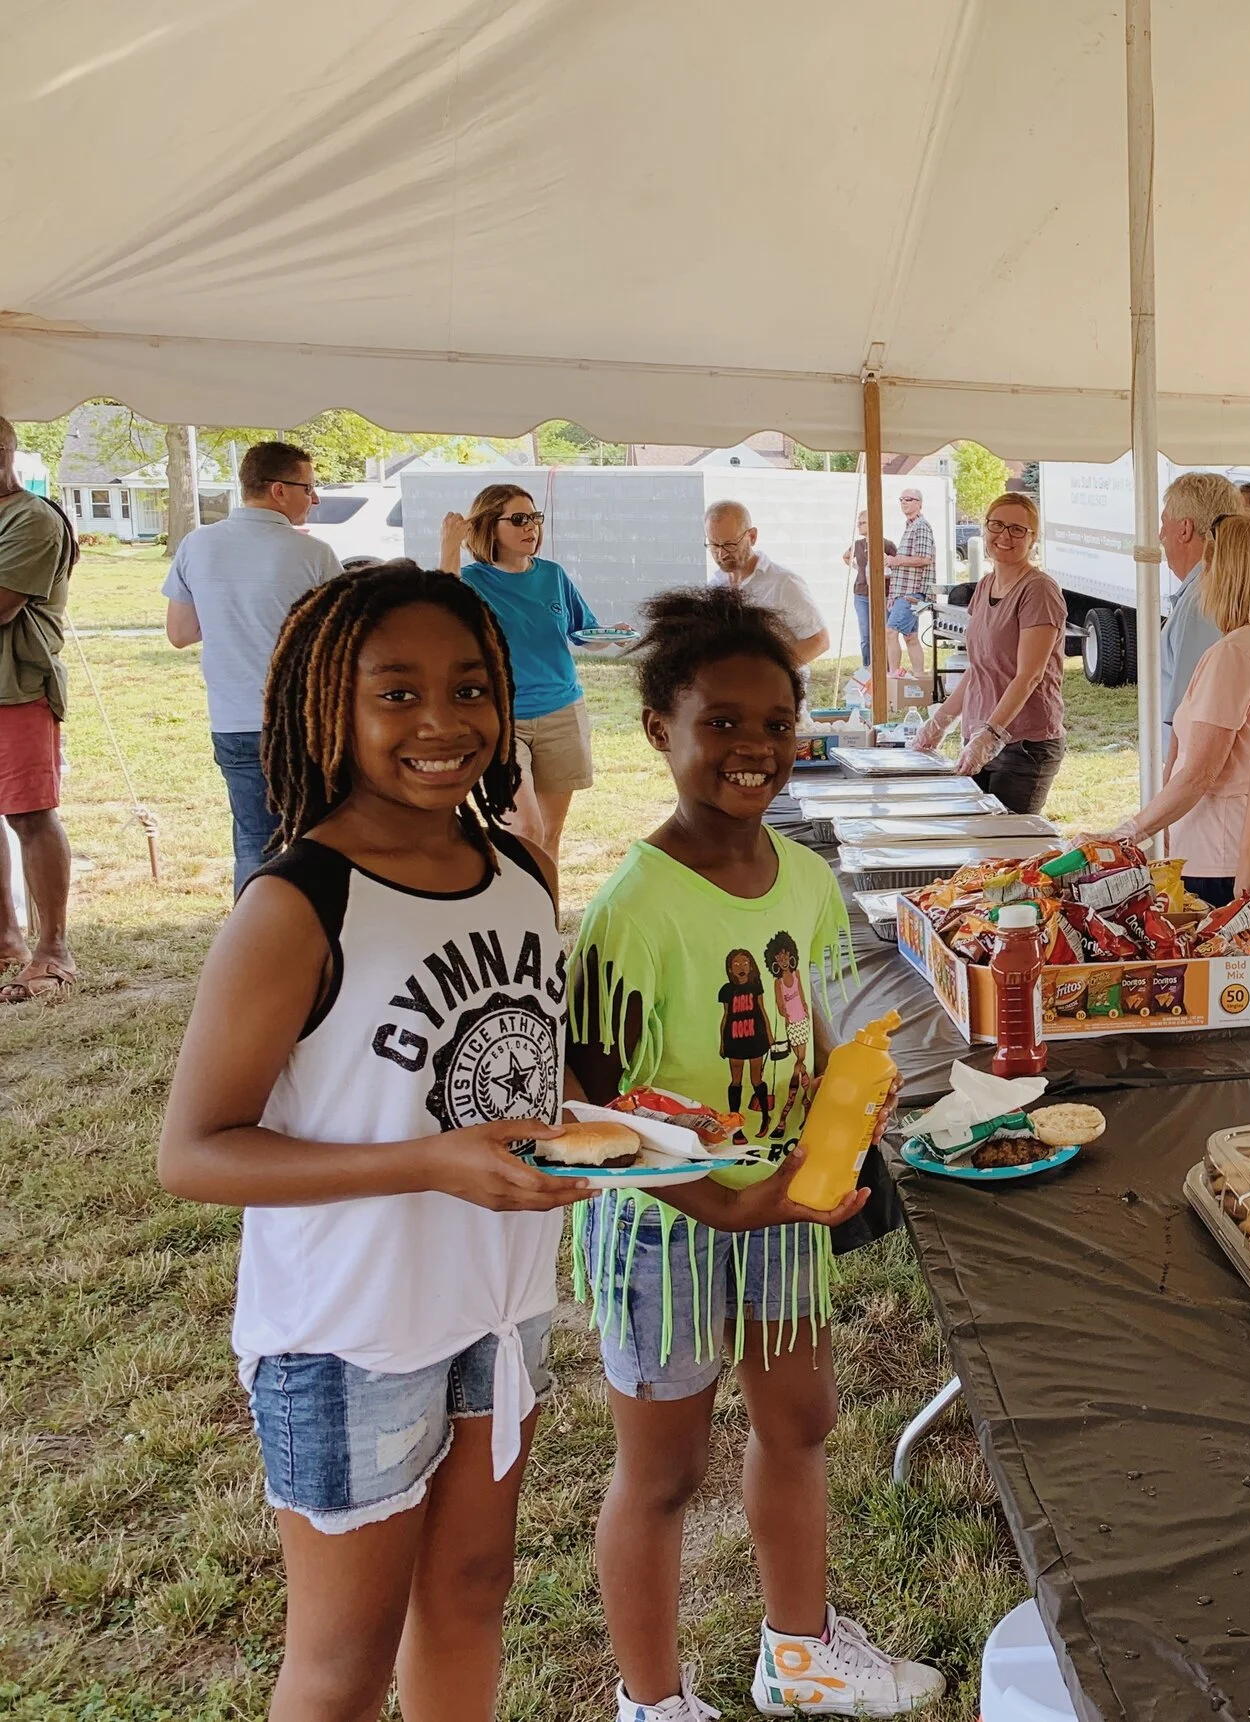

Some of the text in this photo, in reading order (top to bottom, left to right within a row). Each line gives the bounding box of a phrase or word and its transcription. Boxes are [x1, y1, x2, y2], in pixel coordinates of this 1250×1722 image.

[1225, 960, 1246, 970] Bold
[1227, 971, 1244, 980] Mix
[1055, 981, 1082, 999] Fritos
[1227, 989, 1244, 1003] 50
[372, 929, 567, 1072] GYMNAS
[732, 992, 754, 1014] GIRLS
[732, 1018, 755, 1039] ROCK
[454, 1027, 491, 1119] JUSTICE
